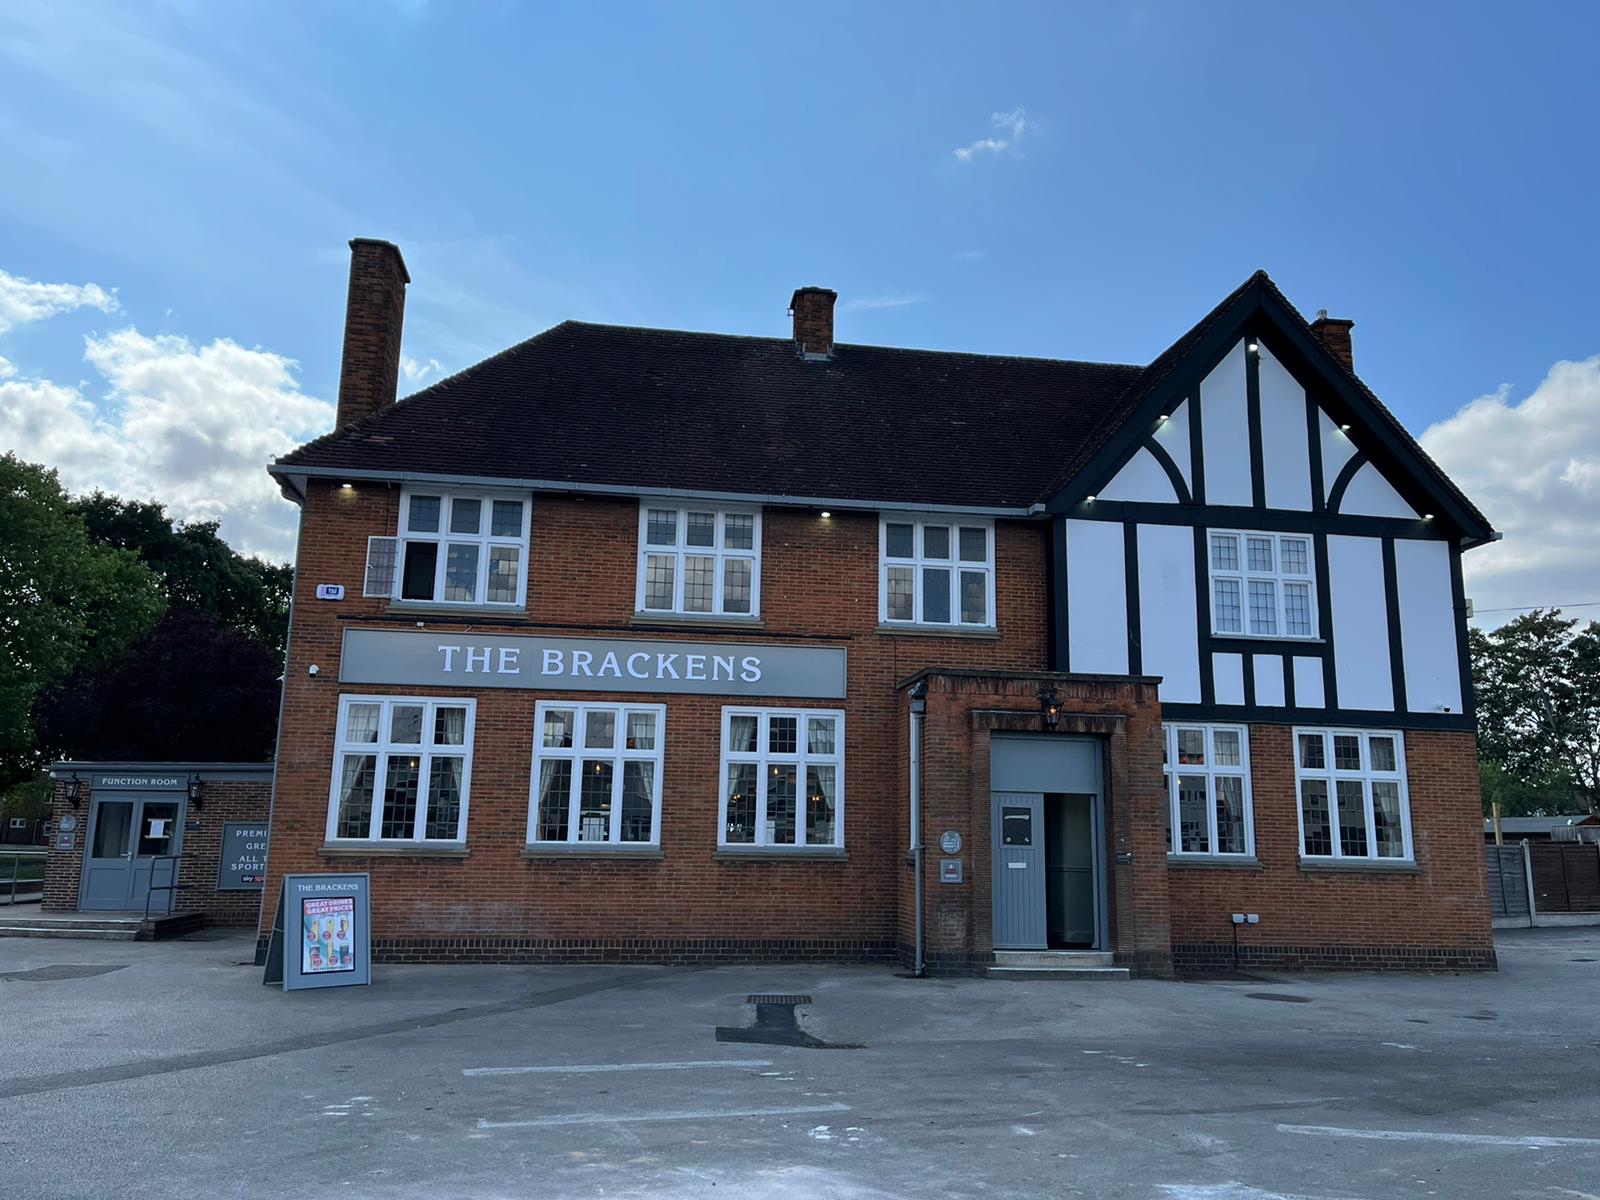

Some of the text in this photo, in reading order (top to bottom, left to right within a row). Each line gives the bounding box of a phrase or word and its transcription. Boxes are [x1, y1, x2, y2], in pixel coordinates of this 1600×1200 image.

[438, 645, 762, 683] THE BRACKENS
[102, 777, 178, 786] FUNCTION ROOM
[238, 855, 258, 863] ALL
[315, 883, 359, 891] BRACKENS
